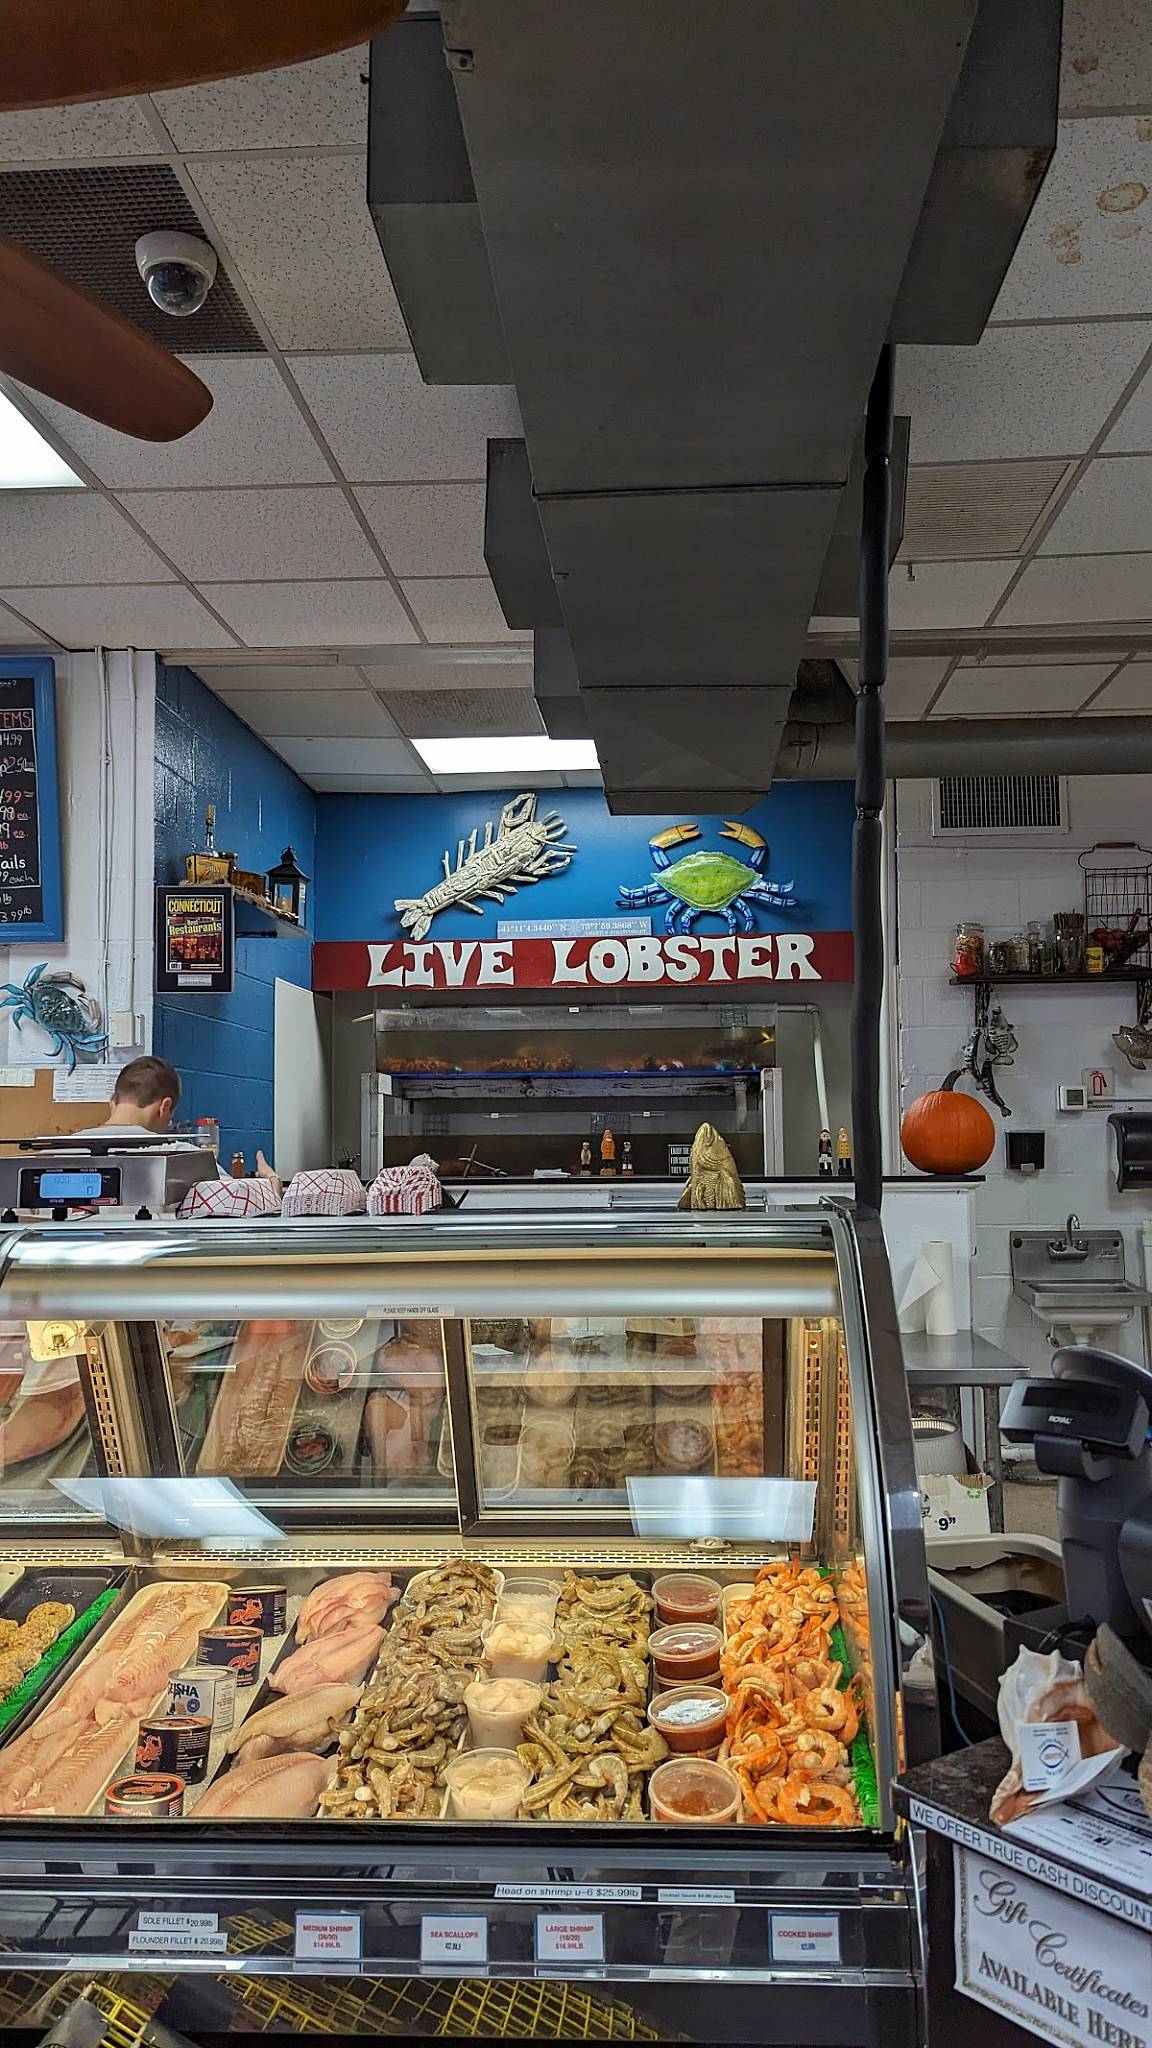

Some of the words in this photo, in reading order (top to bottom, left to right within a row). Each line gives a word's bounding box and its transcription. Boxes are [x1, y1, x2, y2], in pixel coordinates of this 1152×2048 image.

[168, 900, 222, 913] CONNECTICUT
[169, 921, 222, 936] Restaurants
[367, 941, 514, 987] LIVE
[551, 933, 823, 985] LOBSTER
[1047, 1415, 1071, 1424] ROYAL
[912, 1803, 933, 1824] WE
[937, 1816, 981, 1847] OFFER
[986, 1838, 1024, 1867] TRUE
[1027, 1857, 1068, 1888] CASH
[497, 1886, 522, 1895] Head
[540, 1887, 573, 1898] shrimp
[973, 1869, 1028, 1924] Gift
[142, 1917, 160, 1925] SOLE
[162, 1917, 184, 1925] FILLET
[132, 1936, 169, 1945] FLOUNDER
[170, 1936, 192, 1945] FILLET
[1028, 1920, 1149, 2018] Certificates
[979, 1952, 1081, 2028] AVAILABLE
